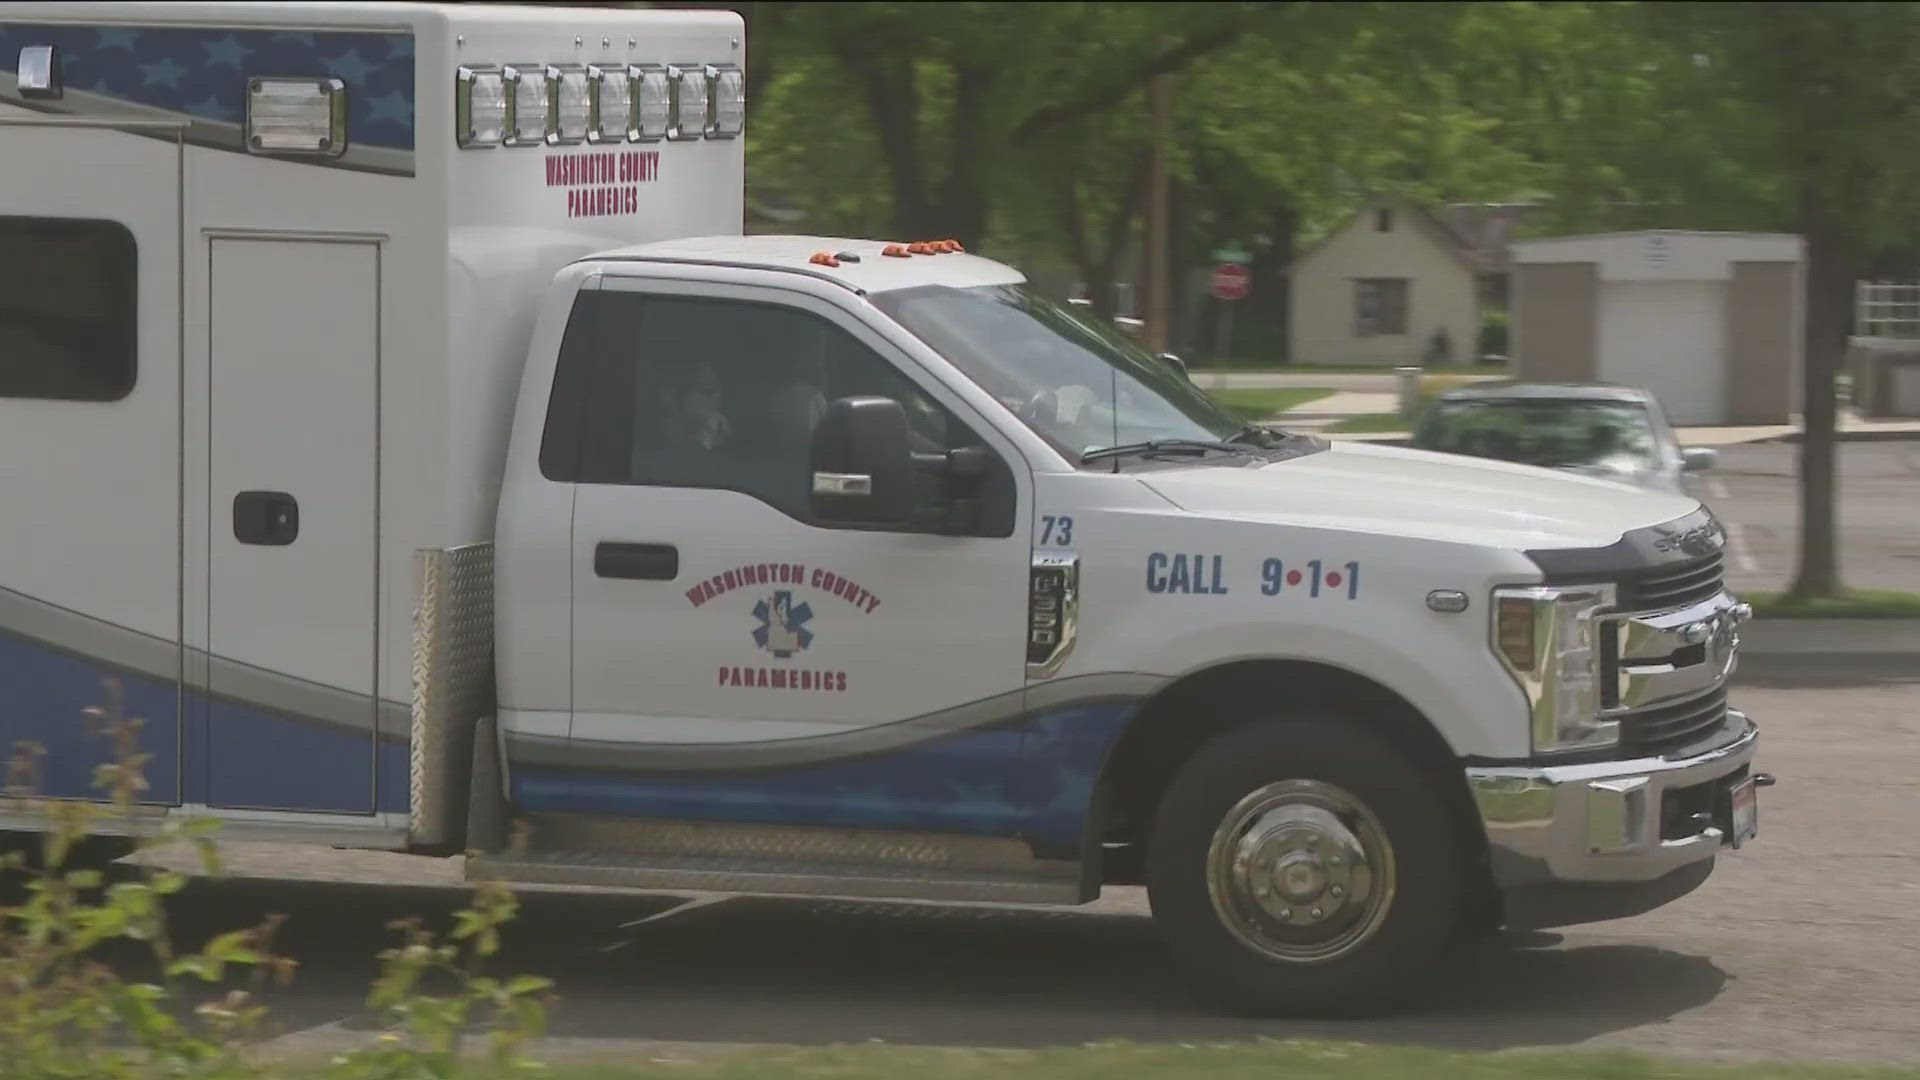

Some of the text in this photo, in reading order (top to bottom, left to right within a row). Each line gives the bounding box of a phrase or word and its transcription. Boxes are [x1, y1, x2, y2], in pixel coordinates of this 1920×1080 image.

[545, 151, 660, 186] WASHINGTON COUNTY
[568, 186, 638, 218] PARAMEDICS
[1040, 515, 1073, 546] 73
[685, 563, 881, 614] WASHINGTON COUNTY
[1147, 553, 1228, 594] CALL
[719, 667, 847, 691] PARAMEDICS
